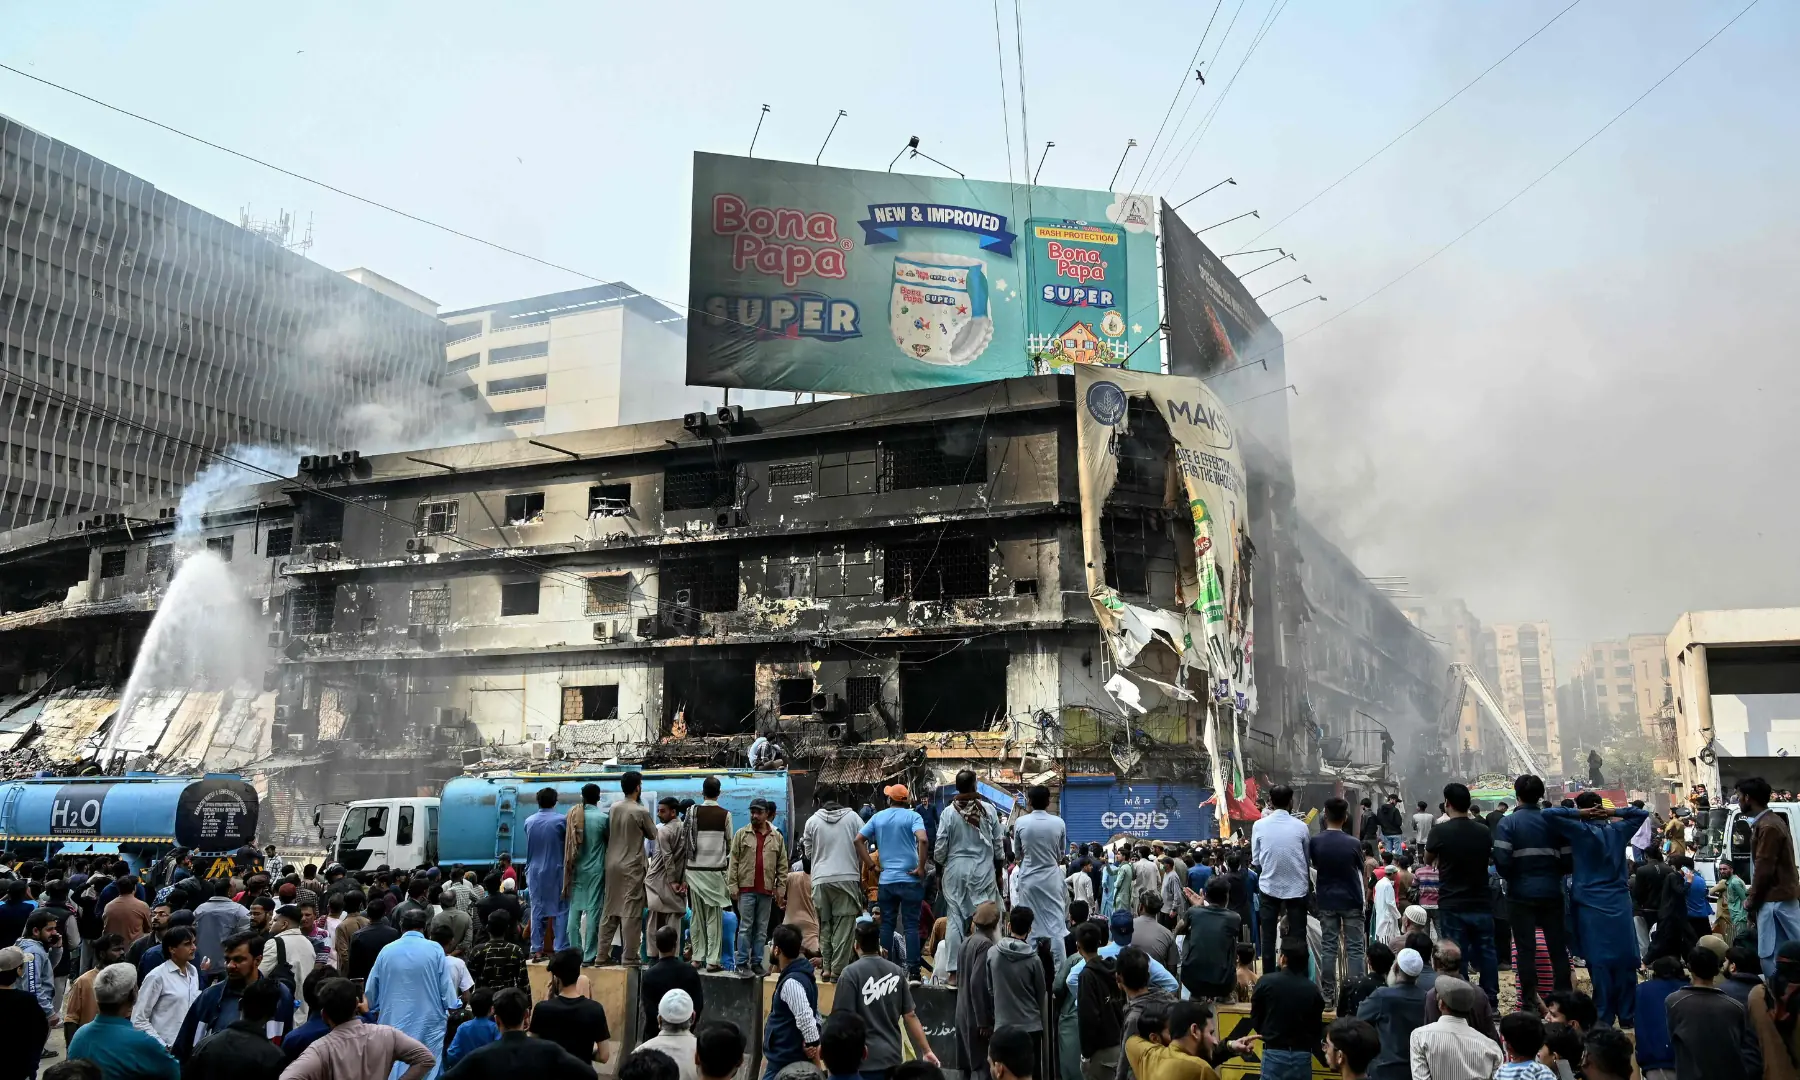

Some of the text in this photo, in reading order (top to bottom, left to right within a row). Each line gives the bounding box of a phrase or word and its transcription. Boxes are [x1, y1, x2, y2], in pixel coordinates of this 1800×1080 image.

[712, 193, 838, 243] Bona
[874, 206, 1000, 232] NEW & IMPROVED
[1039, 228, 1114, 242] RASH PROTECTION
[733, 233, 847, 287] Papa
[1048, 241, 1101, 264] Bona
[1057, 259, 1105, 283] Papa
[925, 294, 955, 305] SUPER
[1043, 285, 1114, 305] SUPER
[704, 294, 857, 333] SUPER
[1167, 399, 1229, 439] MAK'S
[1193, 451, 1200, 464] &
[1183, 463, 1200, 480] FOR
[1199, 466, 1213, 483] THE
[1124, 796, 1151, 806] M & P
[51, 799, 100, 827] H2O
